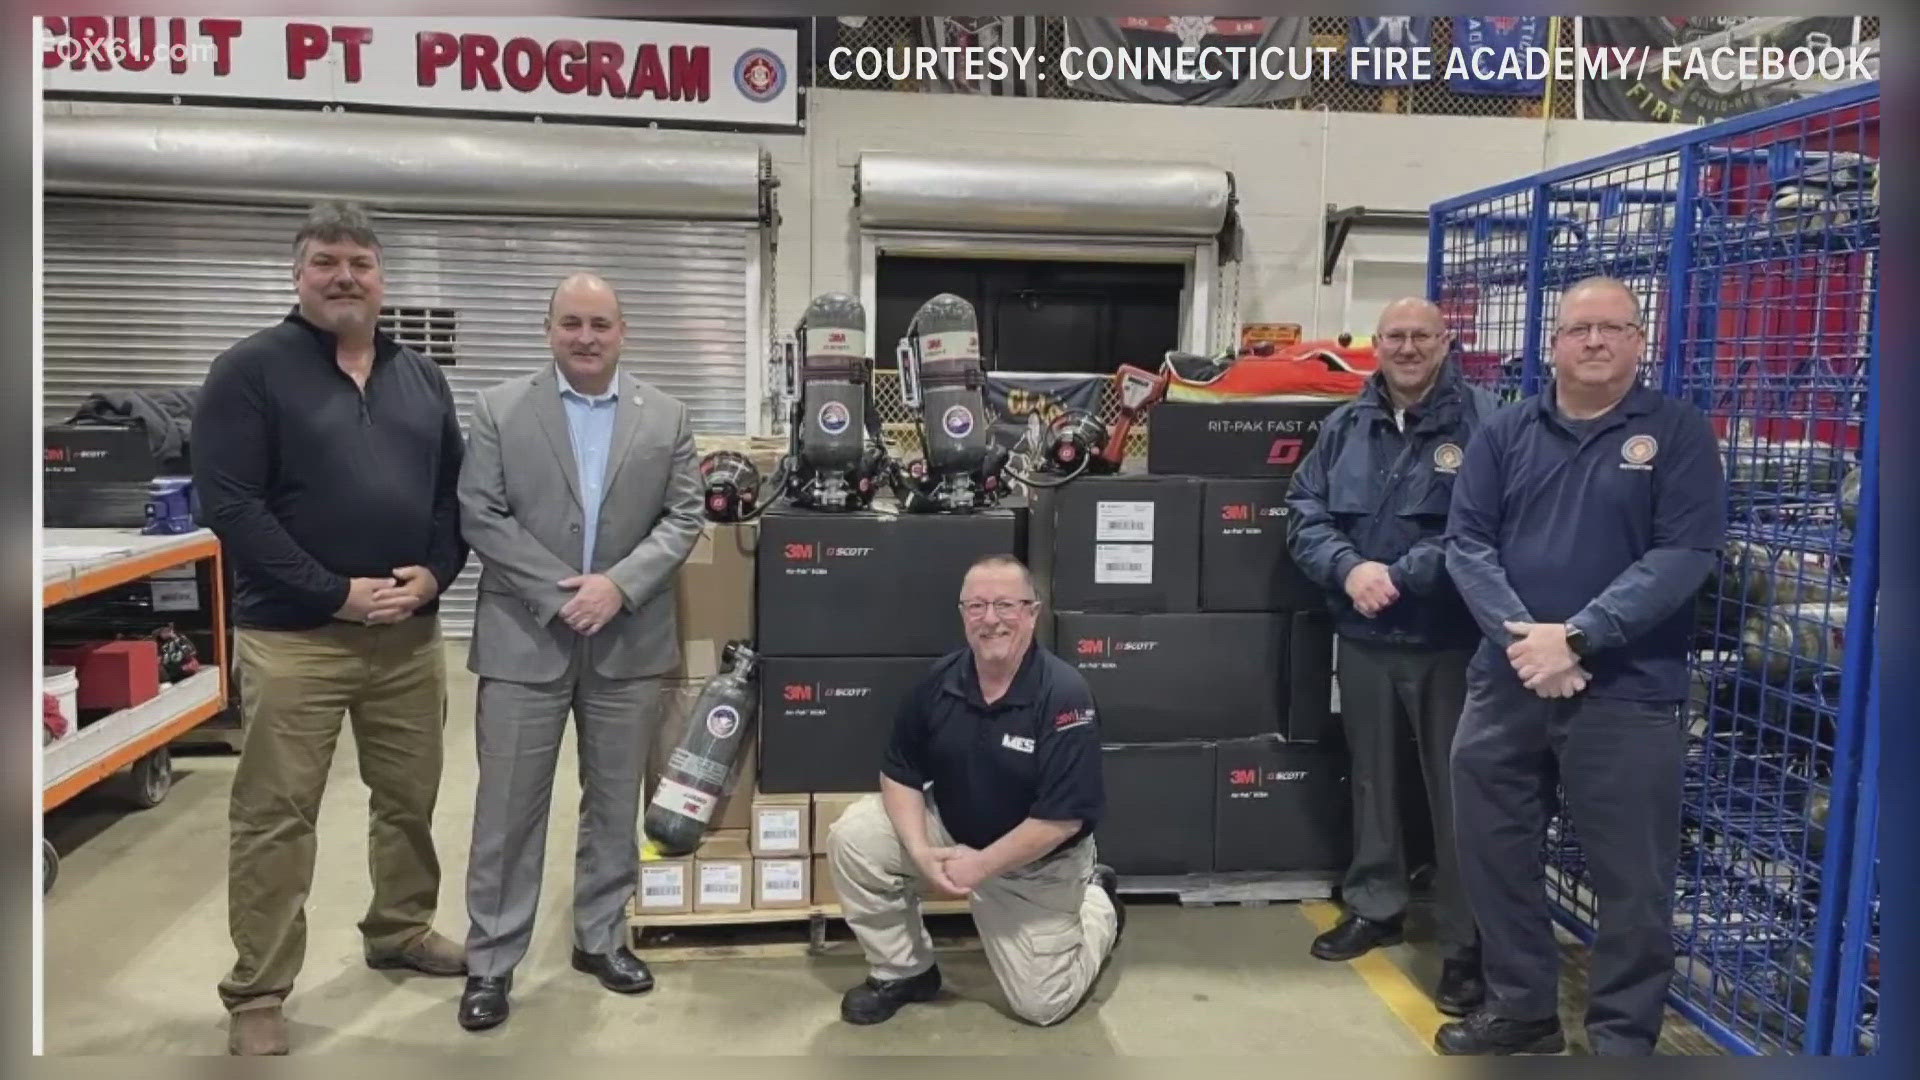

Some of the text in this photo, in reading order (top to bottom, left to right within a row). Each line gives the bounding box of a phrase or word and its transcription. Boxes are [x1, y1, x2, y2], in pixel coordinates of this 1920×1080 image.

[285, 23, 373, 83] PT
[416, 31, 711, 103] PROGRAM
[1208, 420, 1263, 433] RIT-PAK
[1267, 420, 1304, 432] FAST
[1222, 505, 1247, 520] 3M
[784, 543, 869, 559] 3M SCOTT
[1077, 639, 1156, 654] 3M SCOTT
[783, 685, 868, 701] 3M SCOTT
[1230, 768, 1308, 785] 3M SCOTT
